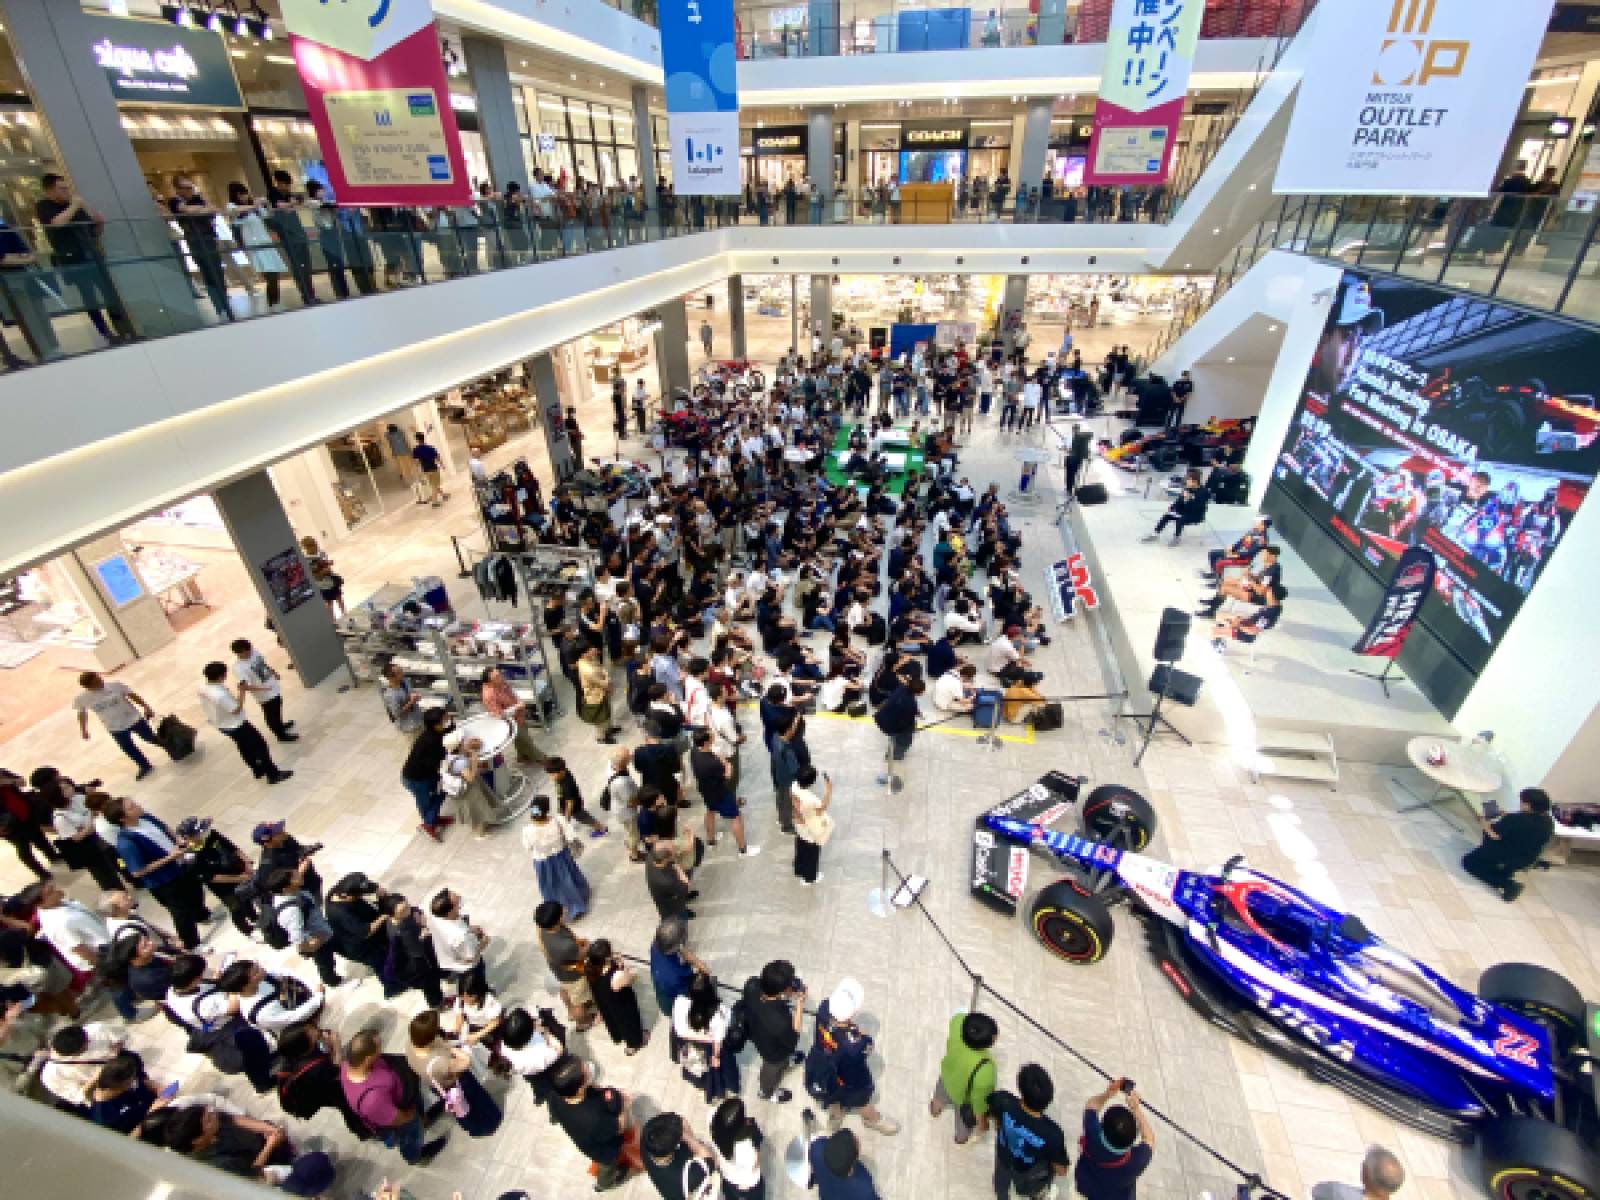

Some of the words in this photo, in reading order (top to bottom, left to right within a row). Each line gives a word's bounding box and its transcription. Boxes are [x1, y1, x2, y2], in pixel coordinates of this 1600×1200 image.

[1365, 92, 1413, 104] MITSUI
[1359, 106, 1448, 126] OUTLET
[907, 129, 962, 142] COACH
[1352, 128, 1412, 147] PARK
[1497, 1023, 1538, 1067] 22
